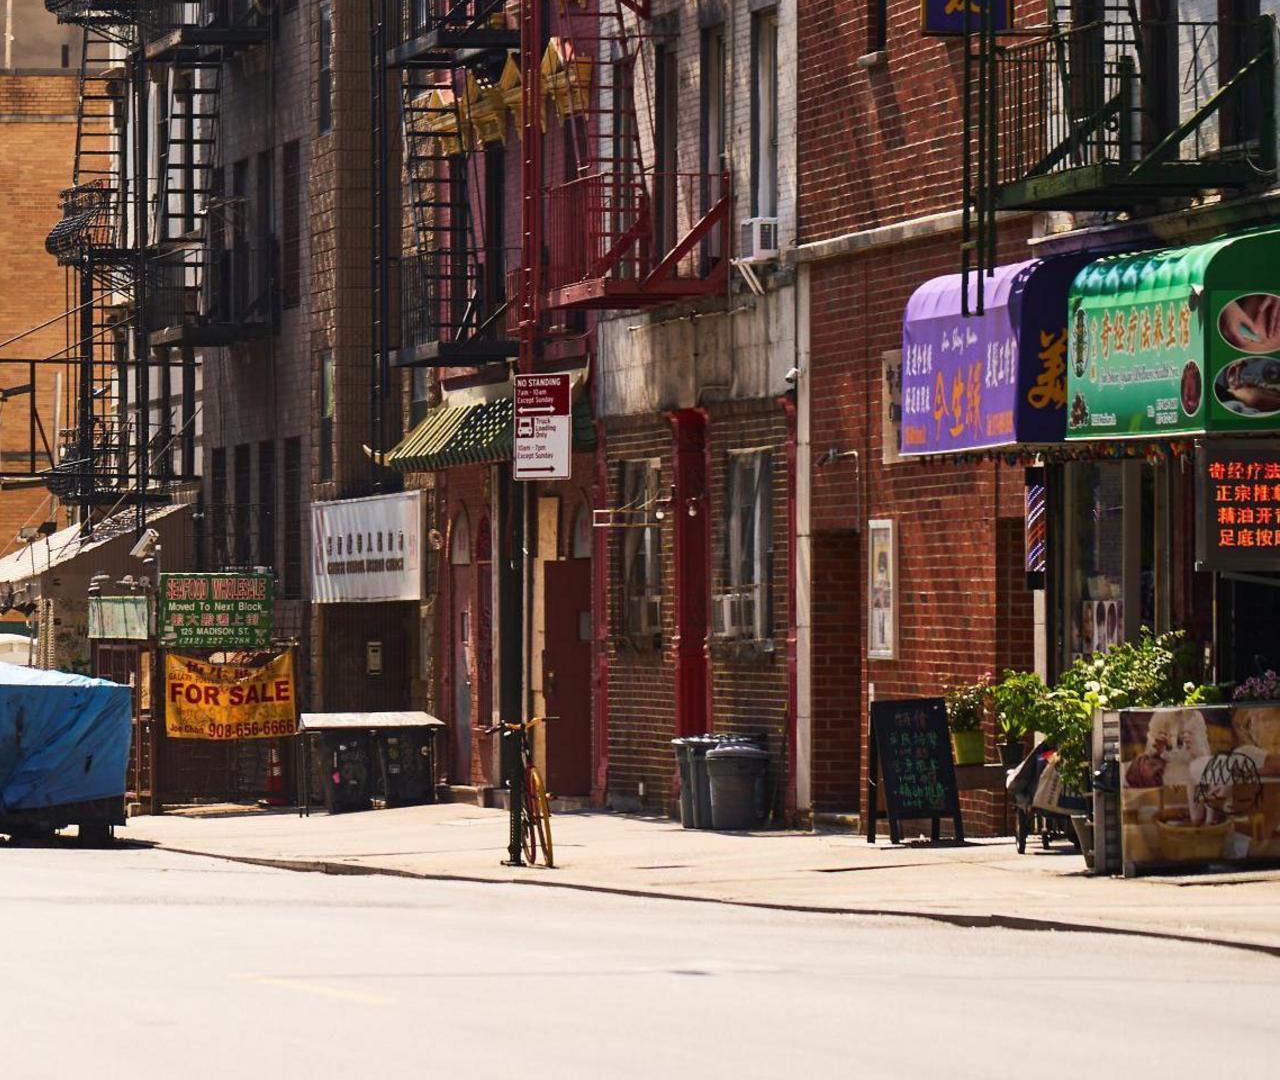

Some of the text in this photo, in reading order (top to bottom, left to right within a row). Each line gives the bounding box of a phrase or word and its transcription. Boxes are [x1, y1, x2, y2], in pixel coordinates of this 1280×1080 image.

[517, 378, 561, 387] NO STANDING
[535, 396, 554, 404] Sunday
[1208, 462, 1280, 480] 奇经疗法
[166, 577, 266, 601] SEAFOOD WHOLESALE
[168, 602, 262, 611] Moved To Next Block
[170, 680, 290, 706] FOR SALE
